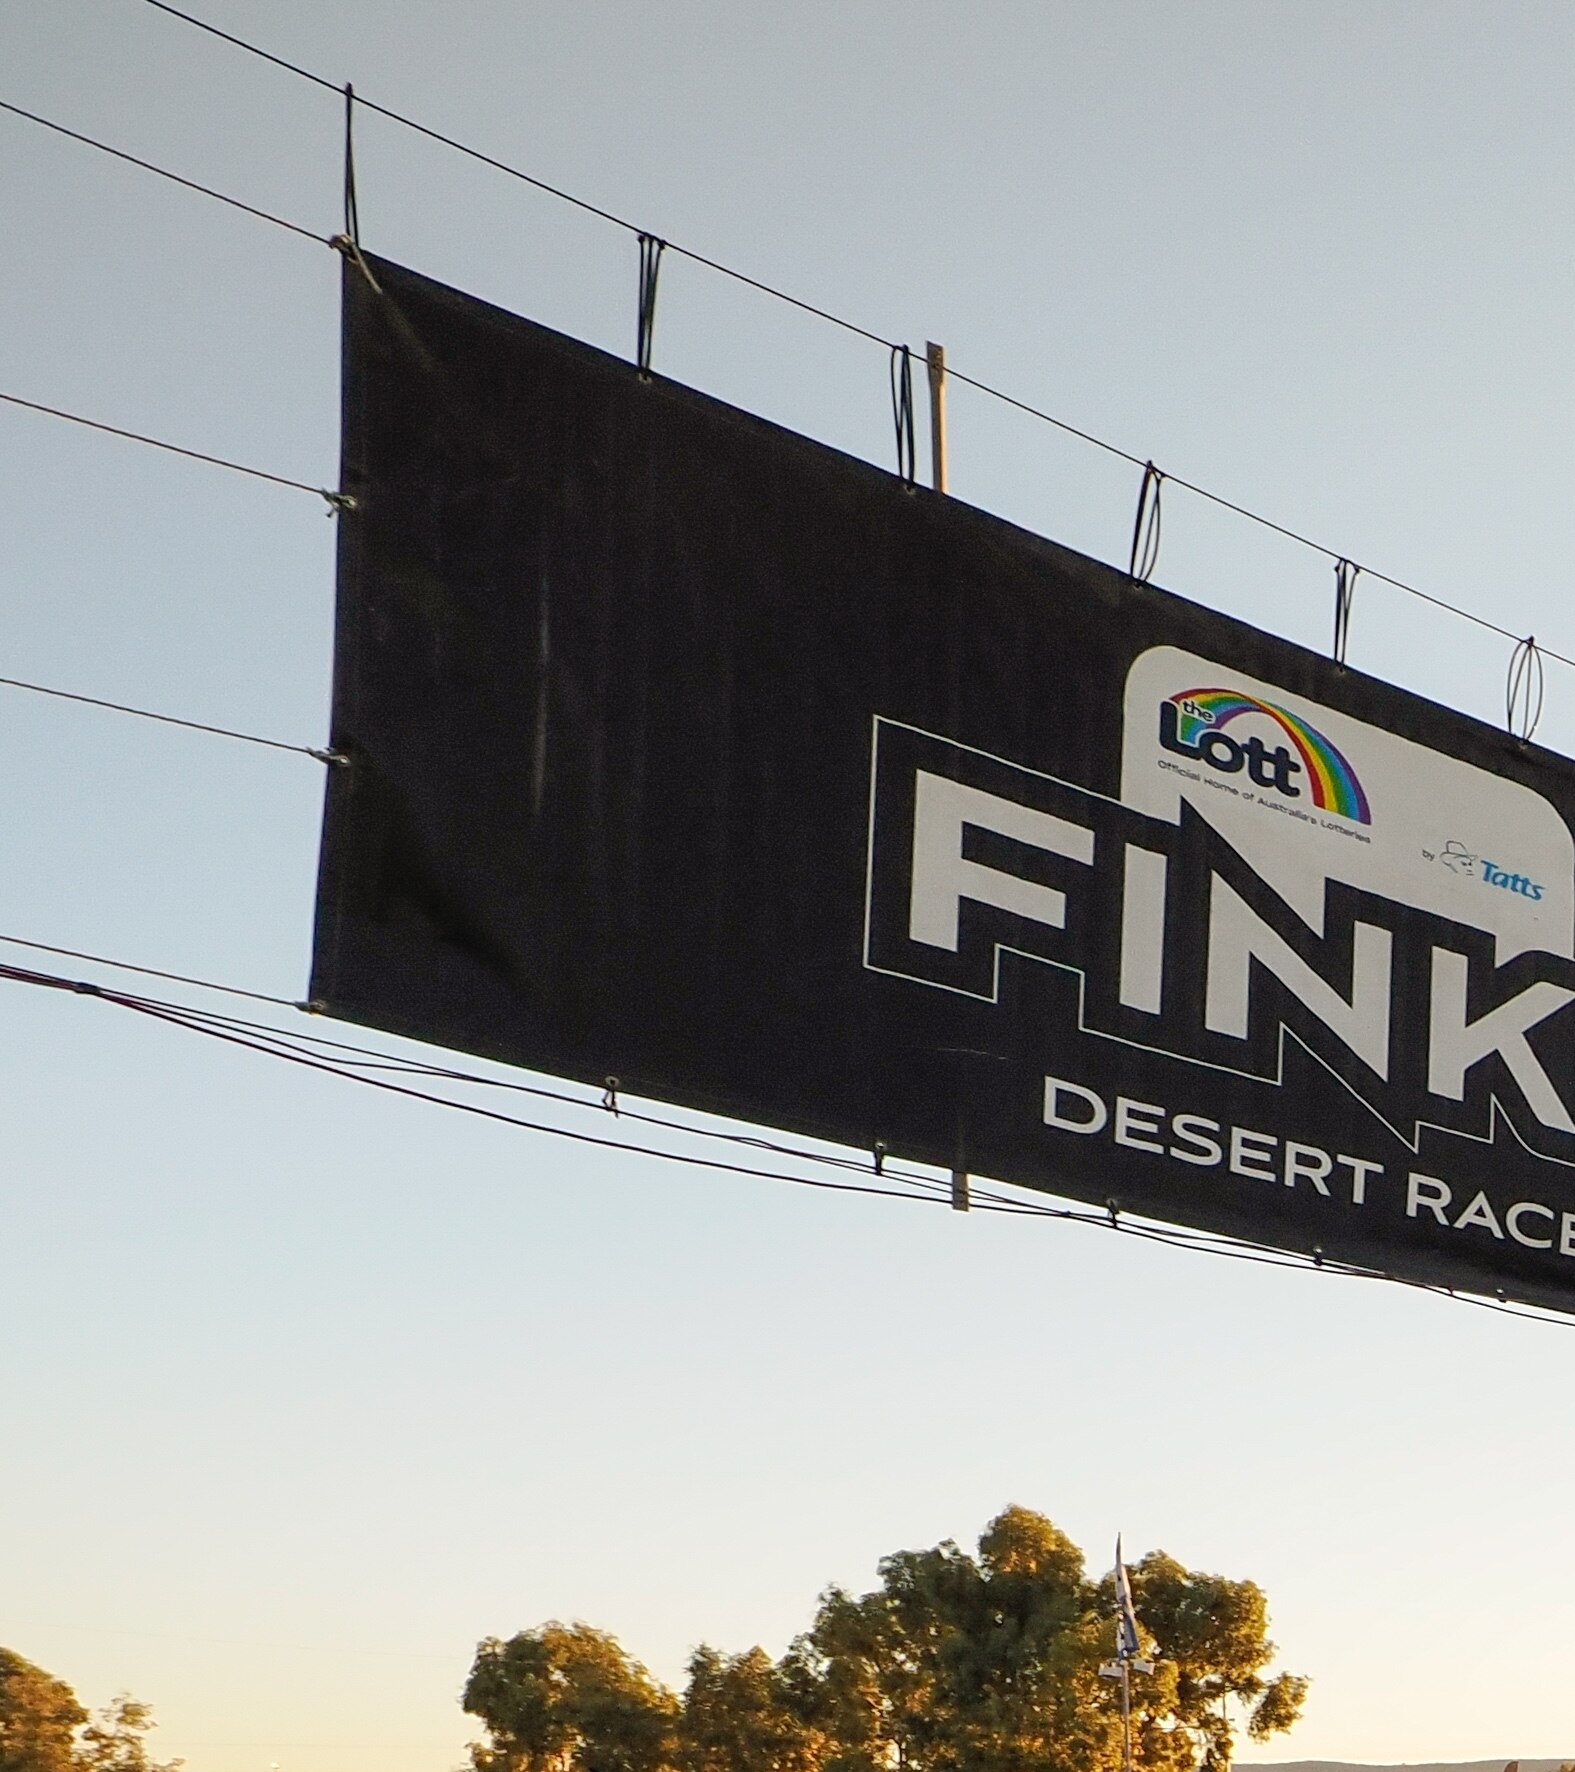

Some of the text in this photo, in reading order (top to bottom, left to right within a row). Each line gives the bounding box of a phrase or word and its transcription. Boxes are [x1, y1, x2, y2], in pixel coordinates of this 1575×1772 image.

[1182, 699, 1215, 723] the
[1159, 700, 1302, 798] Lott
[1422, 849, 1547, 902] by Tatts
[1042, 1075, 1386, 1205] DESERT
